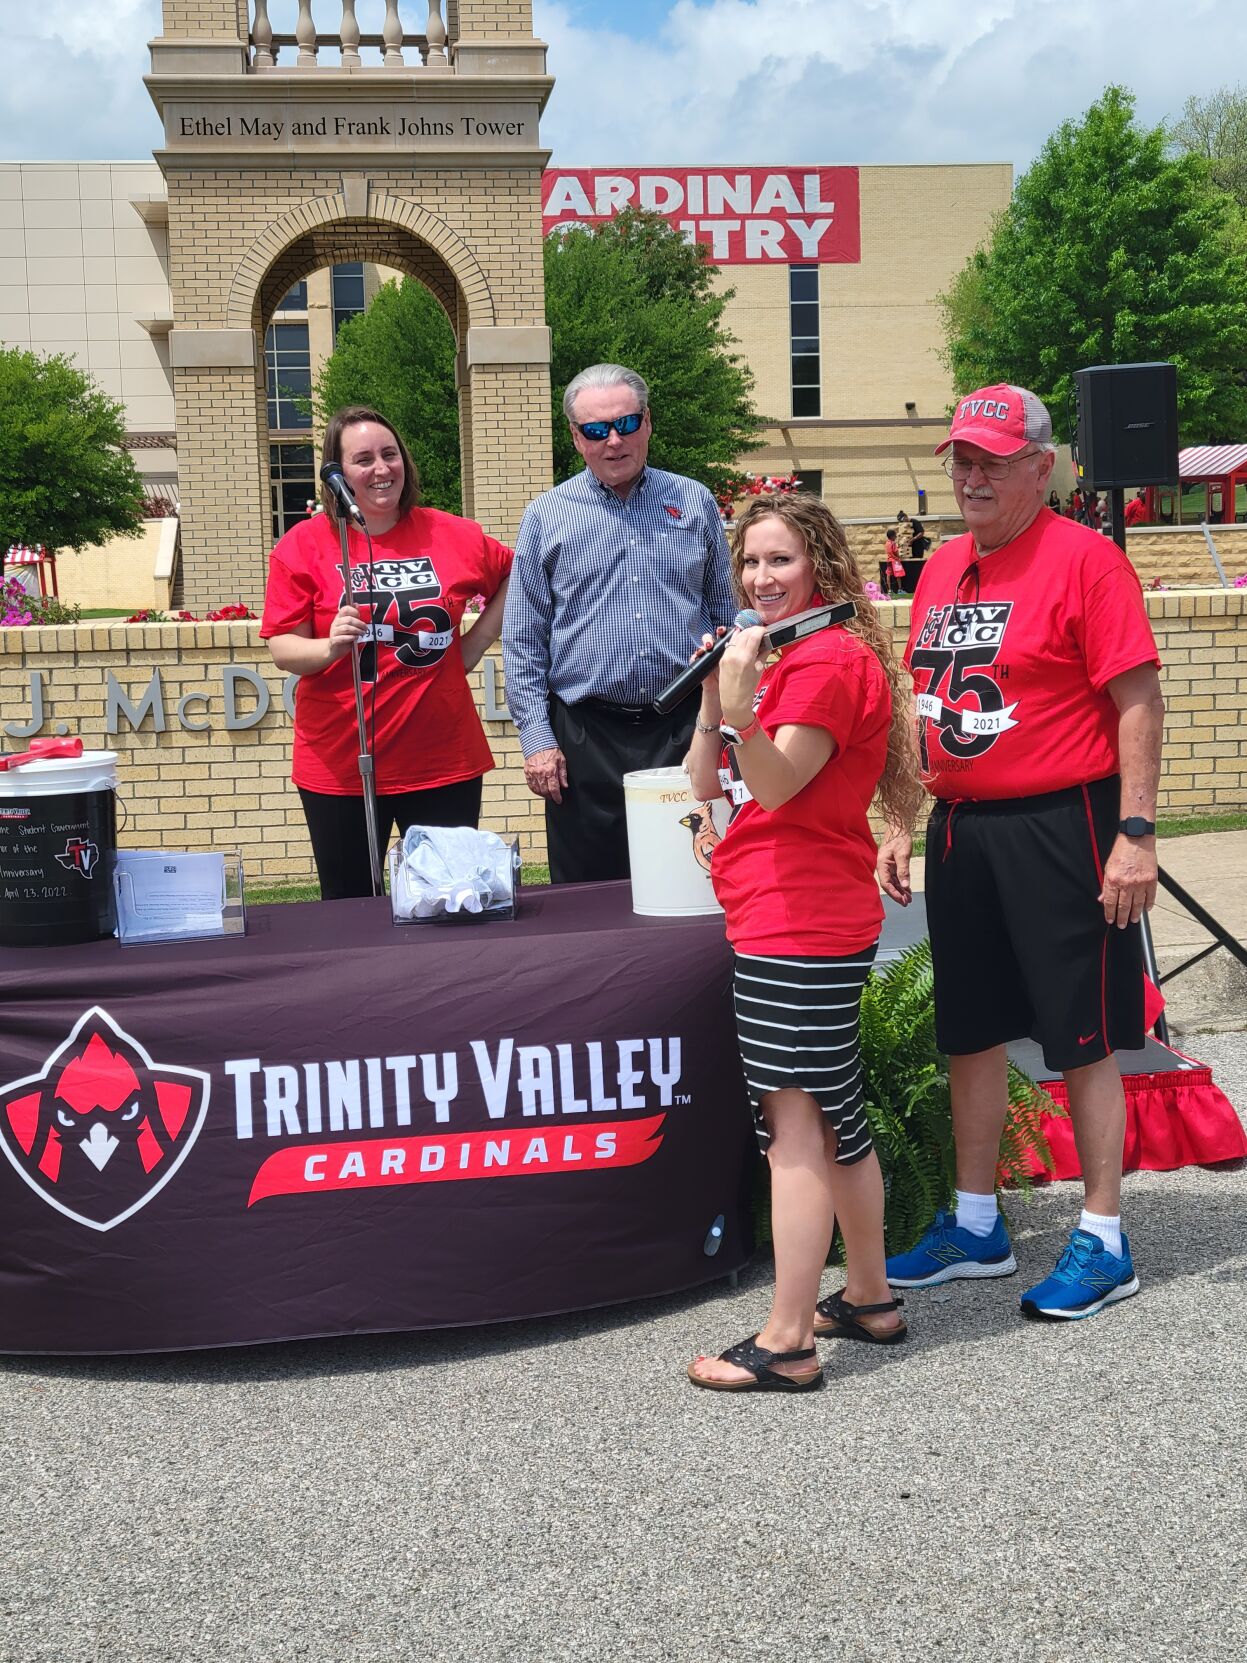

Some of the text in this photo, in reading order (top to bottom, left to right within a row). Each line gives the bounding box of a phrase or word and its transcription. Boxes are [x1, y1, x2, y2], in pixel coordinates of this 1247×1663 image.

[179, 117, 525, 140] Ethel May and Frank Johns Tower
[959, 399, 1010, 421] TVCC
[339, 585, 452, 684] 75
[428, 636, 449, 647] 2021
[992, 664, 1010, 680] TH
[4, 672, 71, 738] J.
[910, 646, 1005, 774] 75
[973, 718, 1000, 730] 2021
[24, 844, 38, 854] the
[69, 844, 91, 870] TV
[4, 887, 20, 900] April
[223, 1051, 459, 1140] TRINITY
[469, 1036, 683, 1120] VALLEY
[303, 1132, 618, 1181] CARDINALS
